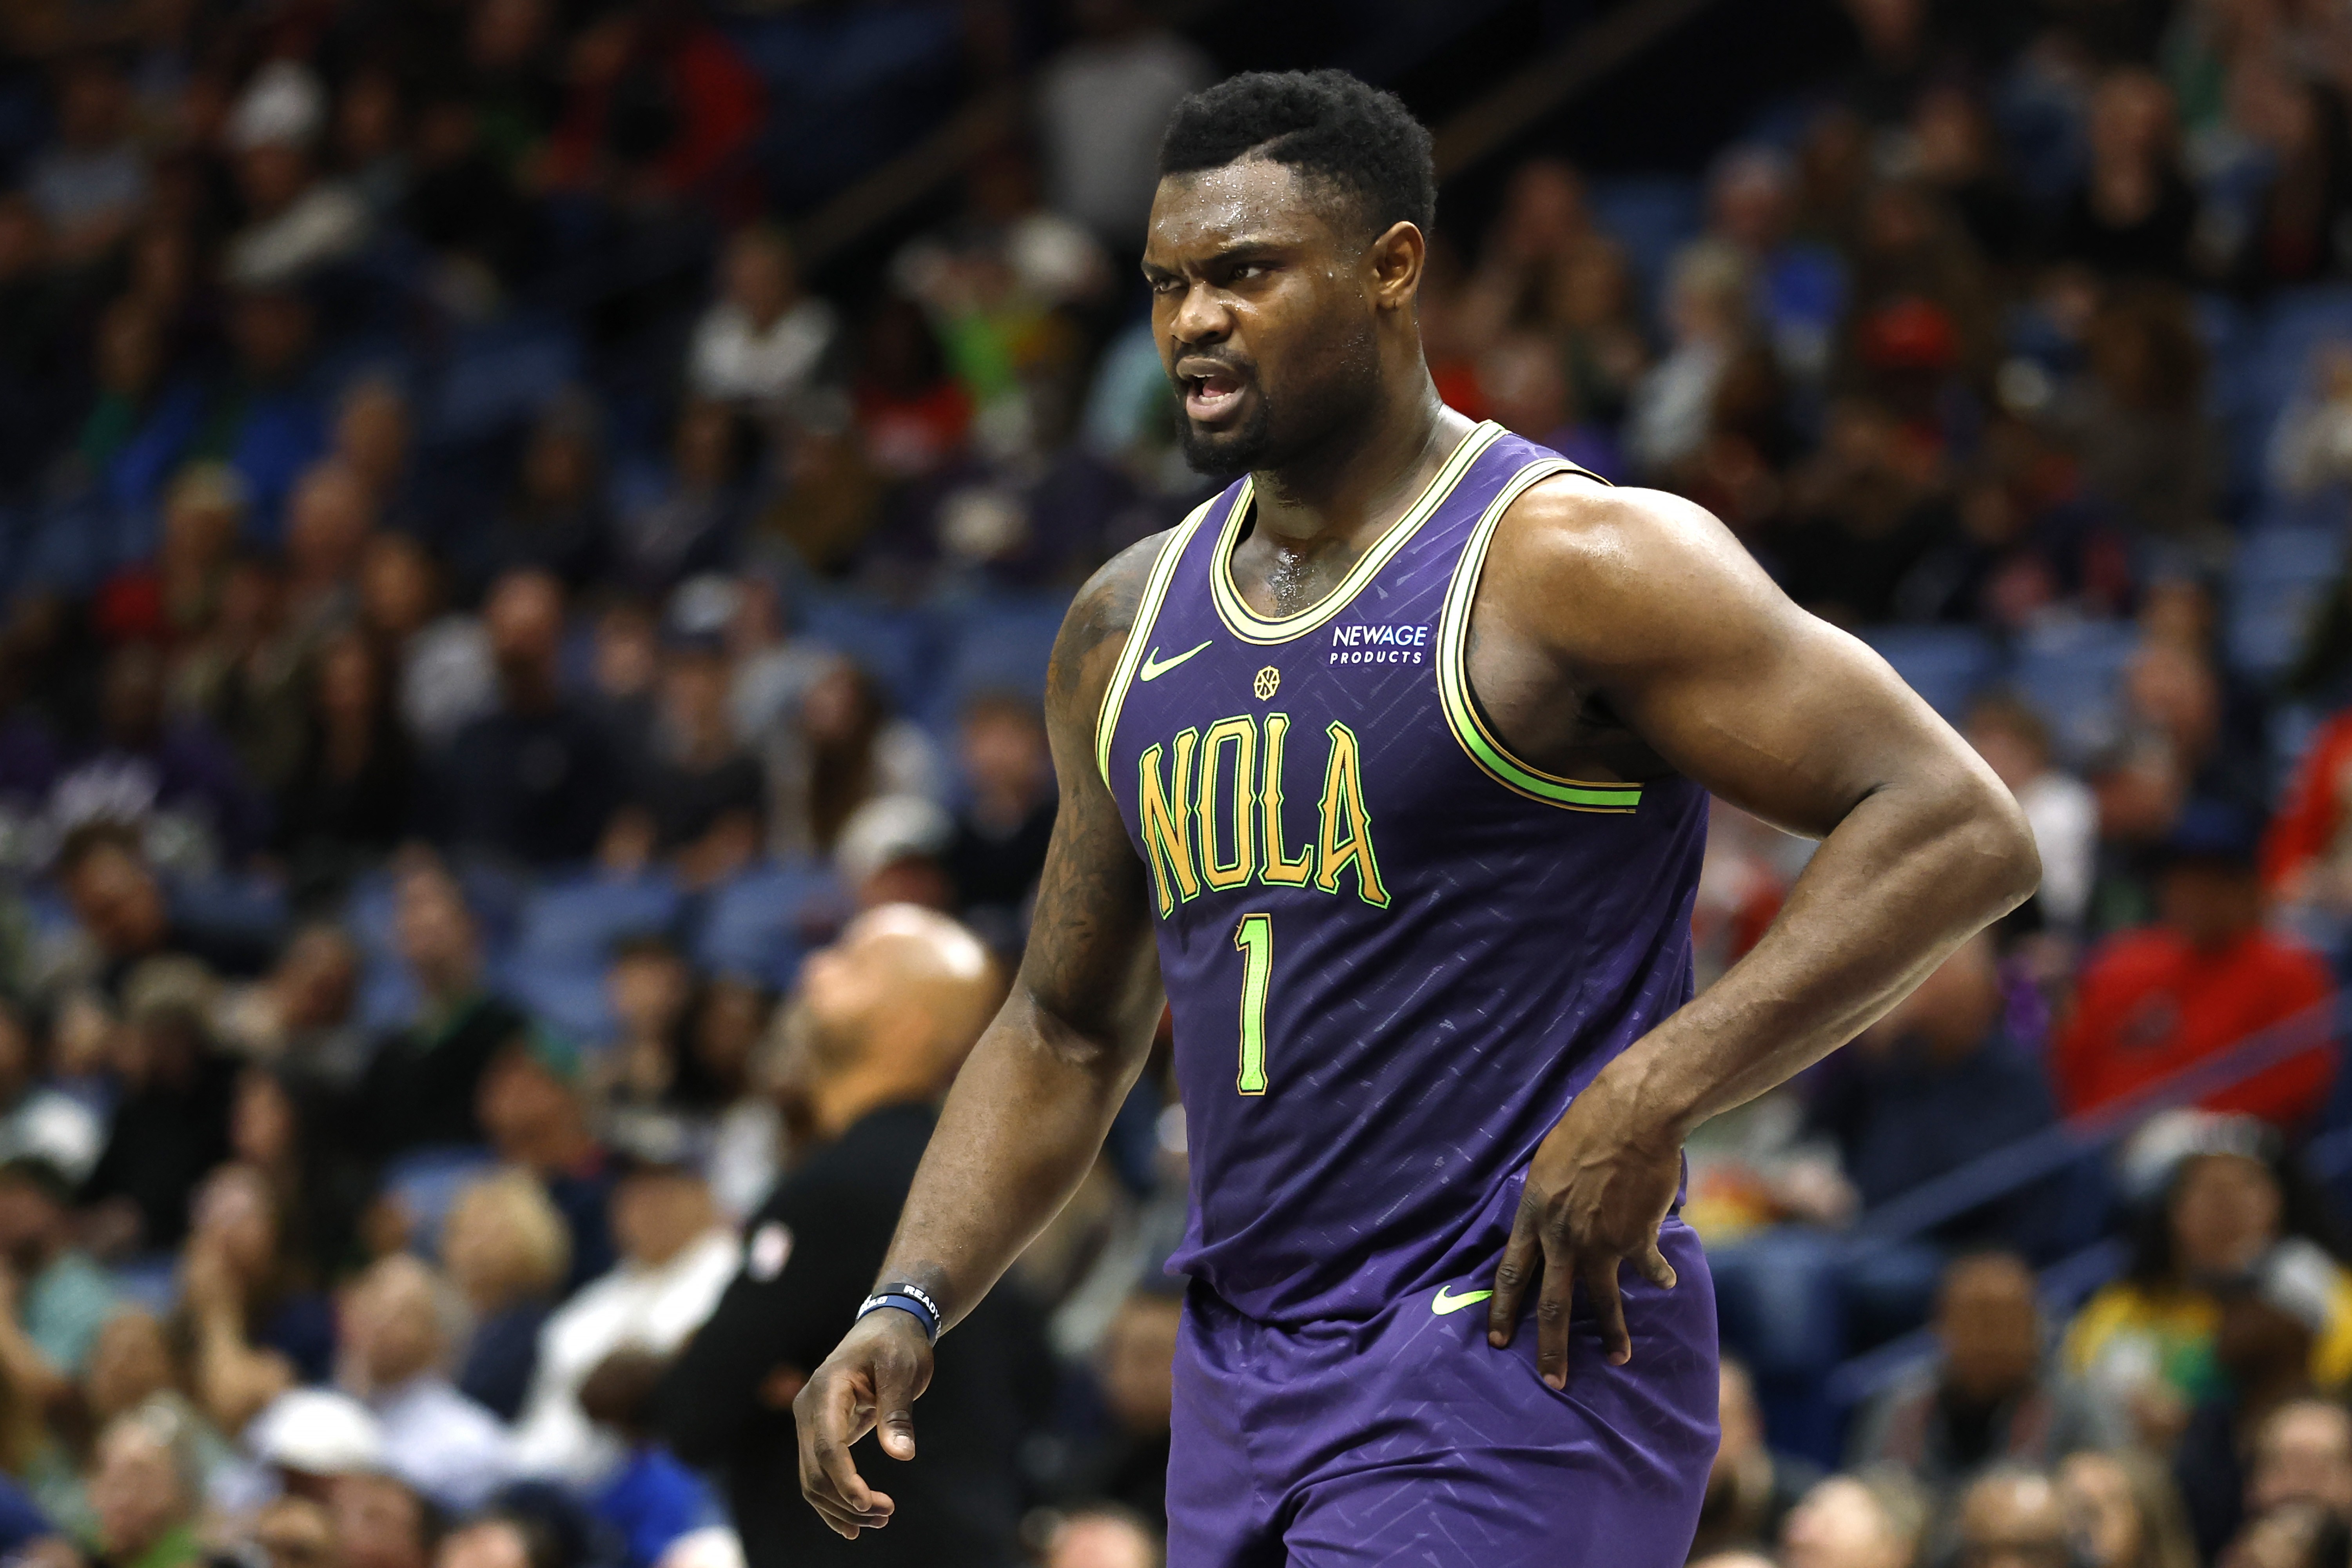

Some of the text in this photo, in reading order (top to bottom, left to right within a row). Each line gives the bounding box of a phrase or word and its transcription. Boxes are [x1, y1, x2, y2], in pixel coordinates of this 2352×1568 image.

[1333, 625, 1428, 647] NEWAGE
[1330, 651, 1422, 664] PRODUCTS
[1138, 712, 1391, 920] NOLA
[1234, 913, 1273, 1095] 1
[903, 1285, 940, 1320] READY
